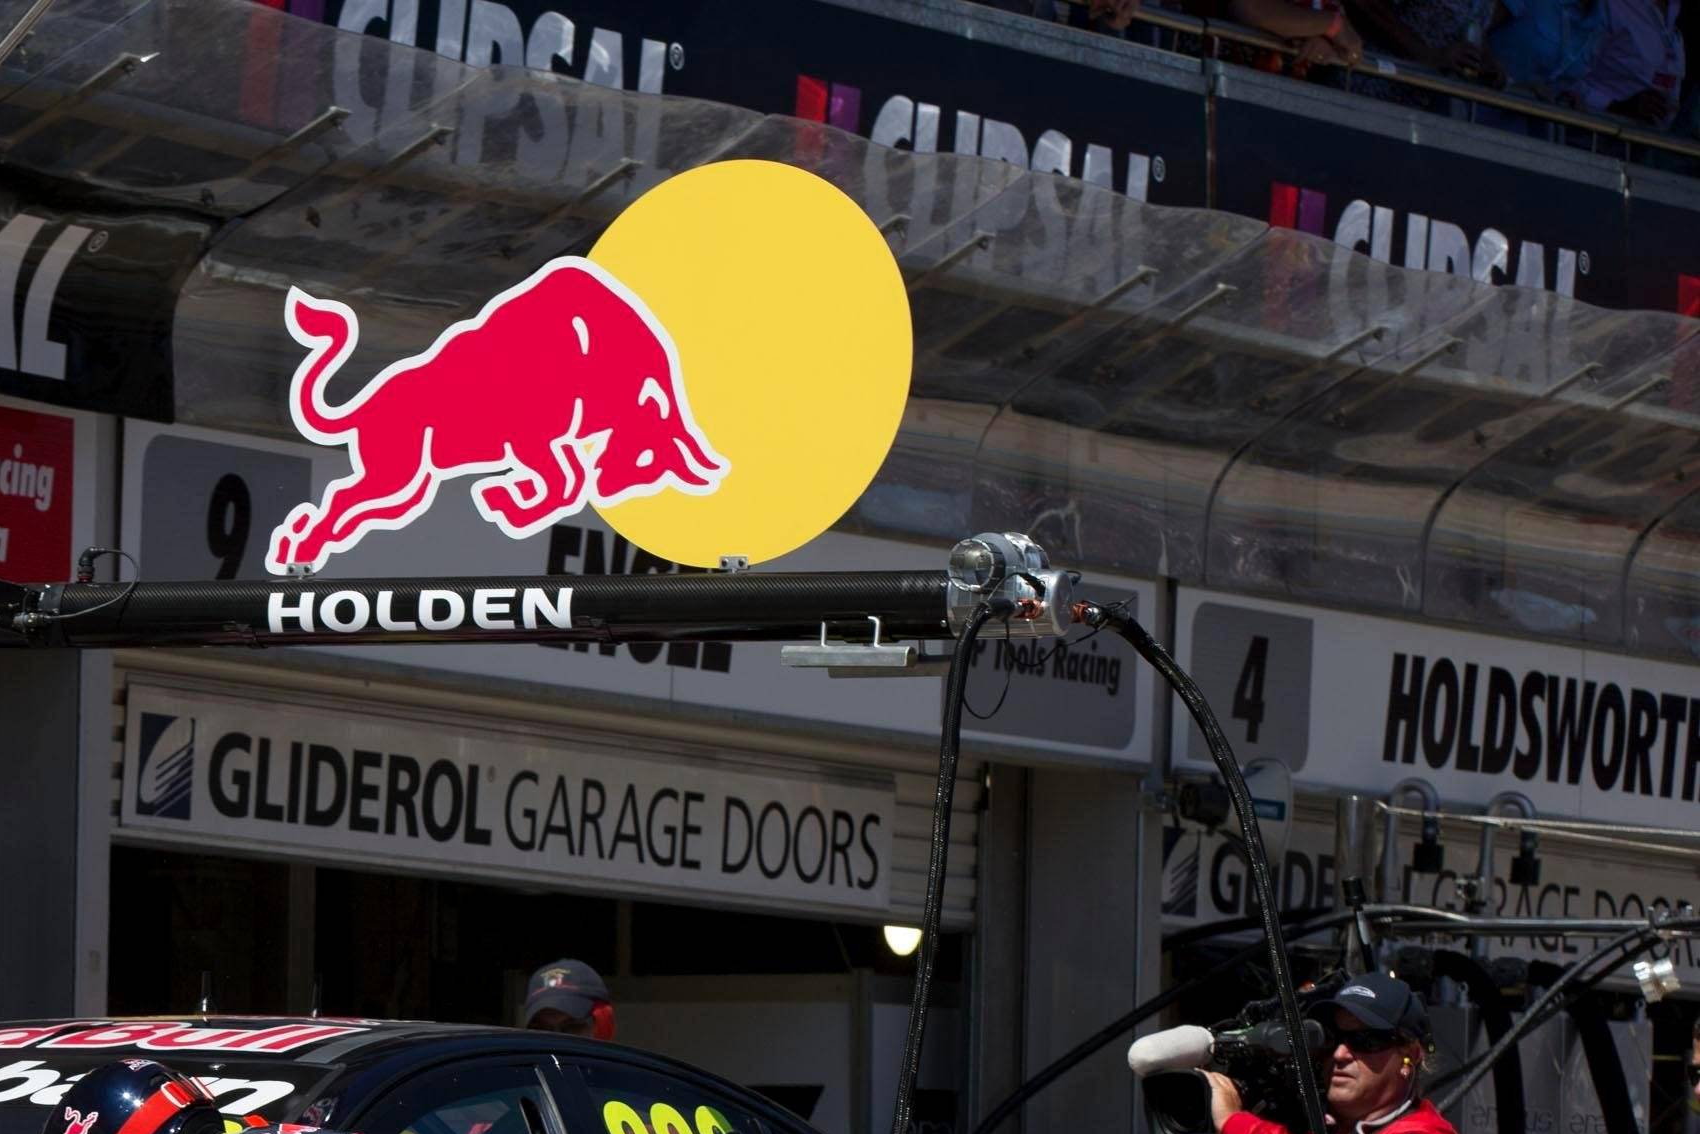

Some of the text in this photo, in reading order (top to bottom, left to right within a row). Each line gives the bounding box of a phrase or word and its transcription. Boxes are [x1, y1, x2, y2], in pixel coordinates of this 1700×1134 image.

[207, 473, 252, 580] 9
[268, 587, 574, 634] HOLDEN
[1053, 639, 1122, 696] Racing
[1232, 635, 1268, 743] 4
[208, 731, 882, 892] GLIDEROL GARAGE DOORS
[40, 1020, 372, 1055] Bull
